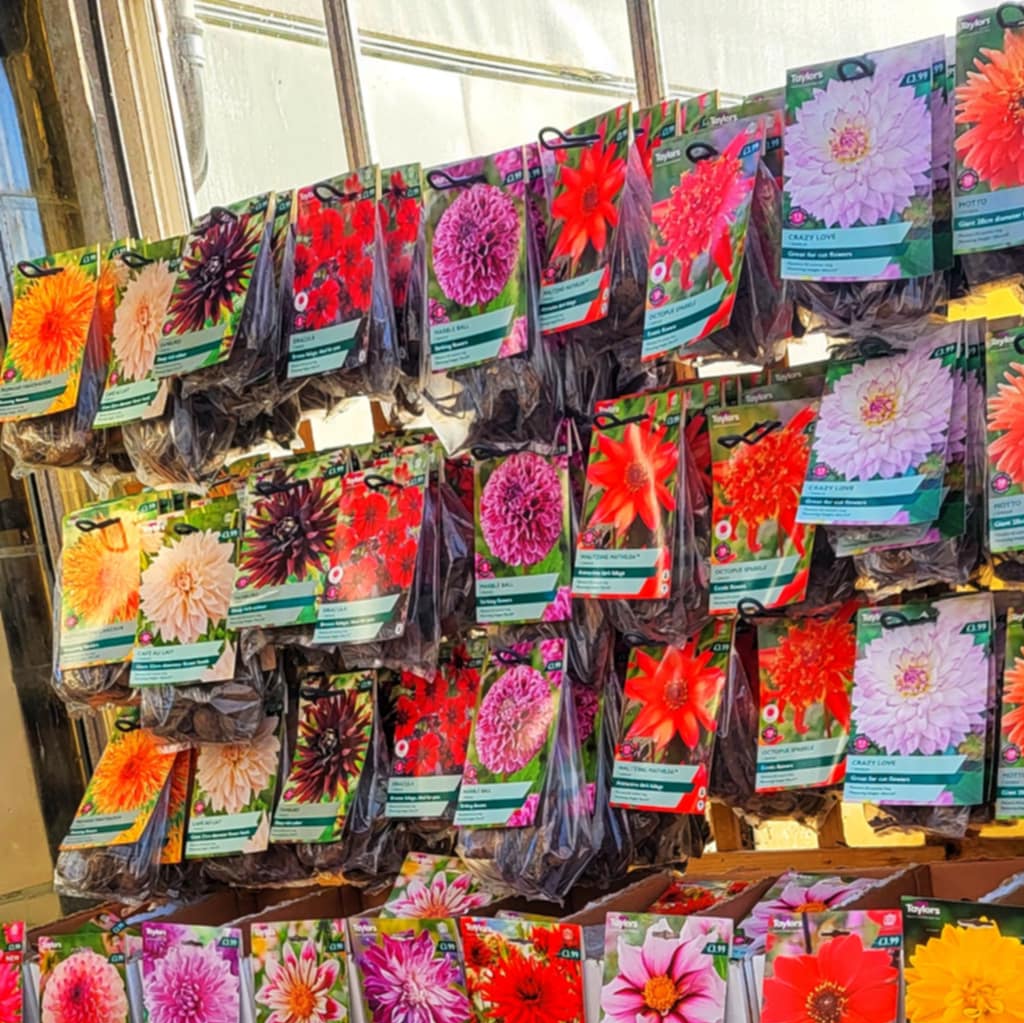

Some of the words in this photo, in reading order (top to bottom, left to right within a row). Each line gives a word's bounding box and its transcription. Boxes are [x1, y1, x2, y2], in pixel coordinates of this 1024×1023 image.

[791, 69, 823, 83] Taylors
[906, 71, 929, 84] £3.99
[788, 233, 813, 241] CRAZY
[816, 232, 836, 240] LOVE
[851, 759, 874, 767] CRAZY
[875, 758, 896, 767] LOVE
[906, 904, 940, 916] Taylors
[878, 937, 900, 946] £3.99
